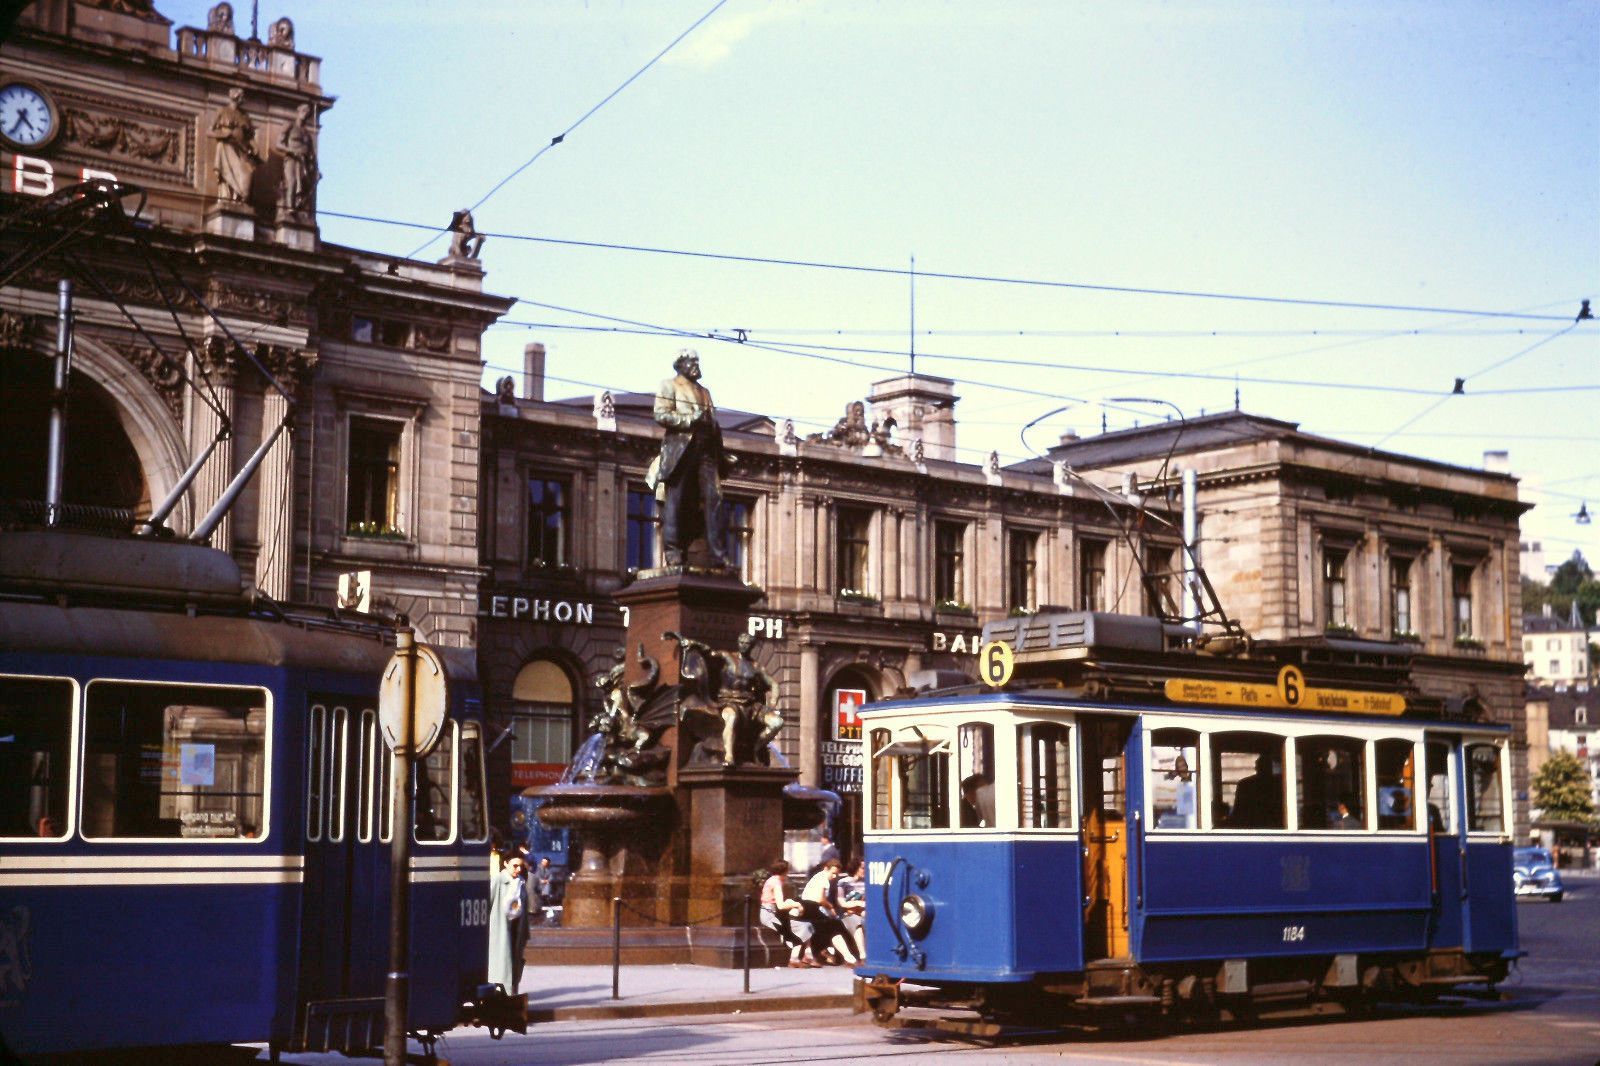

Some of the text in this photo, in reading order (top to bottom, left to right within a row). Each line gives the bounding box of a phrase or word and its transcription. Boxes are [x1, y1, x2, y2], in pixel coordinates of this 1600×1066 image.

[988, 645, 1005, 682] 6
[1284, 670, 1299, 705] 6
[839, 726, 862, 739] PTT
[460, 899, 488, 926] 1388
[1282, 926, 1305, 942] 1184
